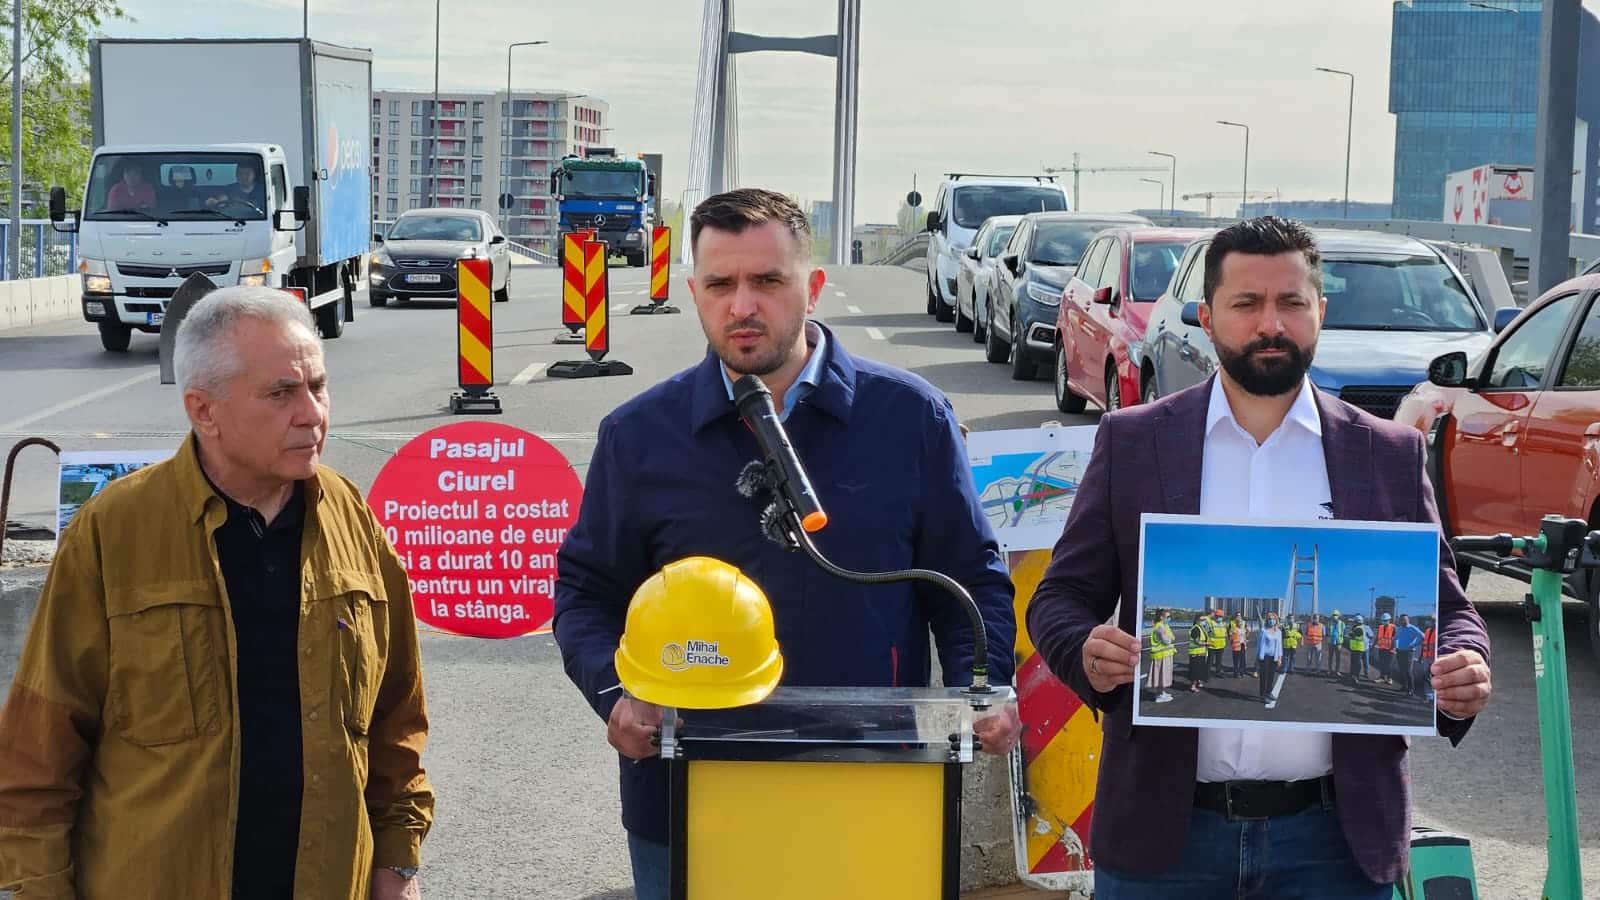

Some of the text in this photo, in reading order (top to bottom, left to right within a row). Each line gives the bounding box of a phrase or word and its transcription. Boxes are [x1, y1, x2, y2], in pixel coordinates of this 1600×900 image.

[431, 438, 524, 462] Pasajul
[438, 470, 514, 491] Ciurel
[384, 499, 569, 520] Proiectul a costat
[405, 525, 494, 545] milioane
[500, 524, 525, 544] de
[419, 554, 431, 570] a
[437, 551, 493, 570] durat
[499, 550, 523, 570] 10
[477, 579, 503, 595] un
[510, 574, 555, 599] viraj
[430, 599, 530, 624] la stânga.
[687, 640, 718, 652] Mihai
[1533, 635, 1545, 678] Bolt
[686, 652, 729, 665] Enache
